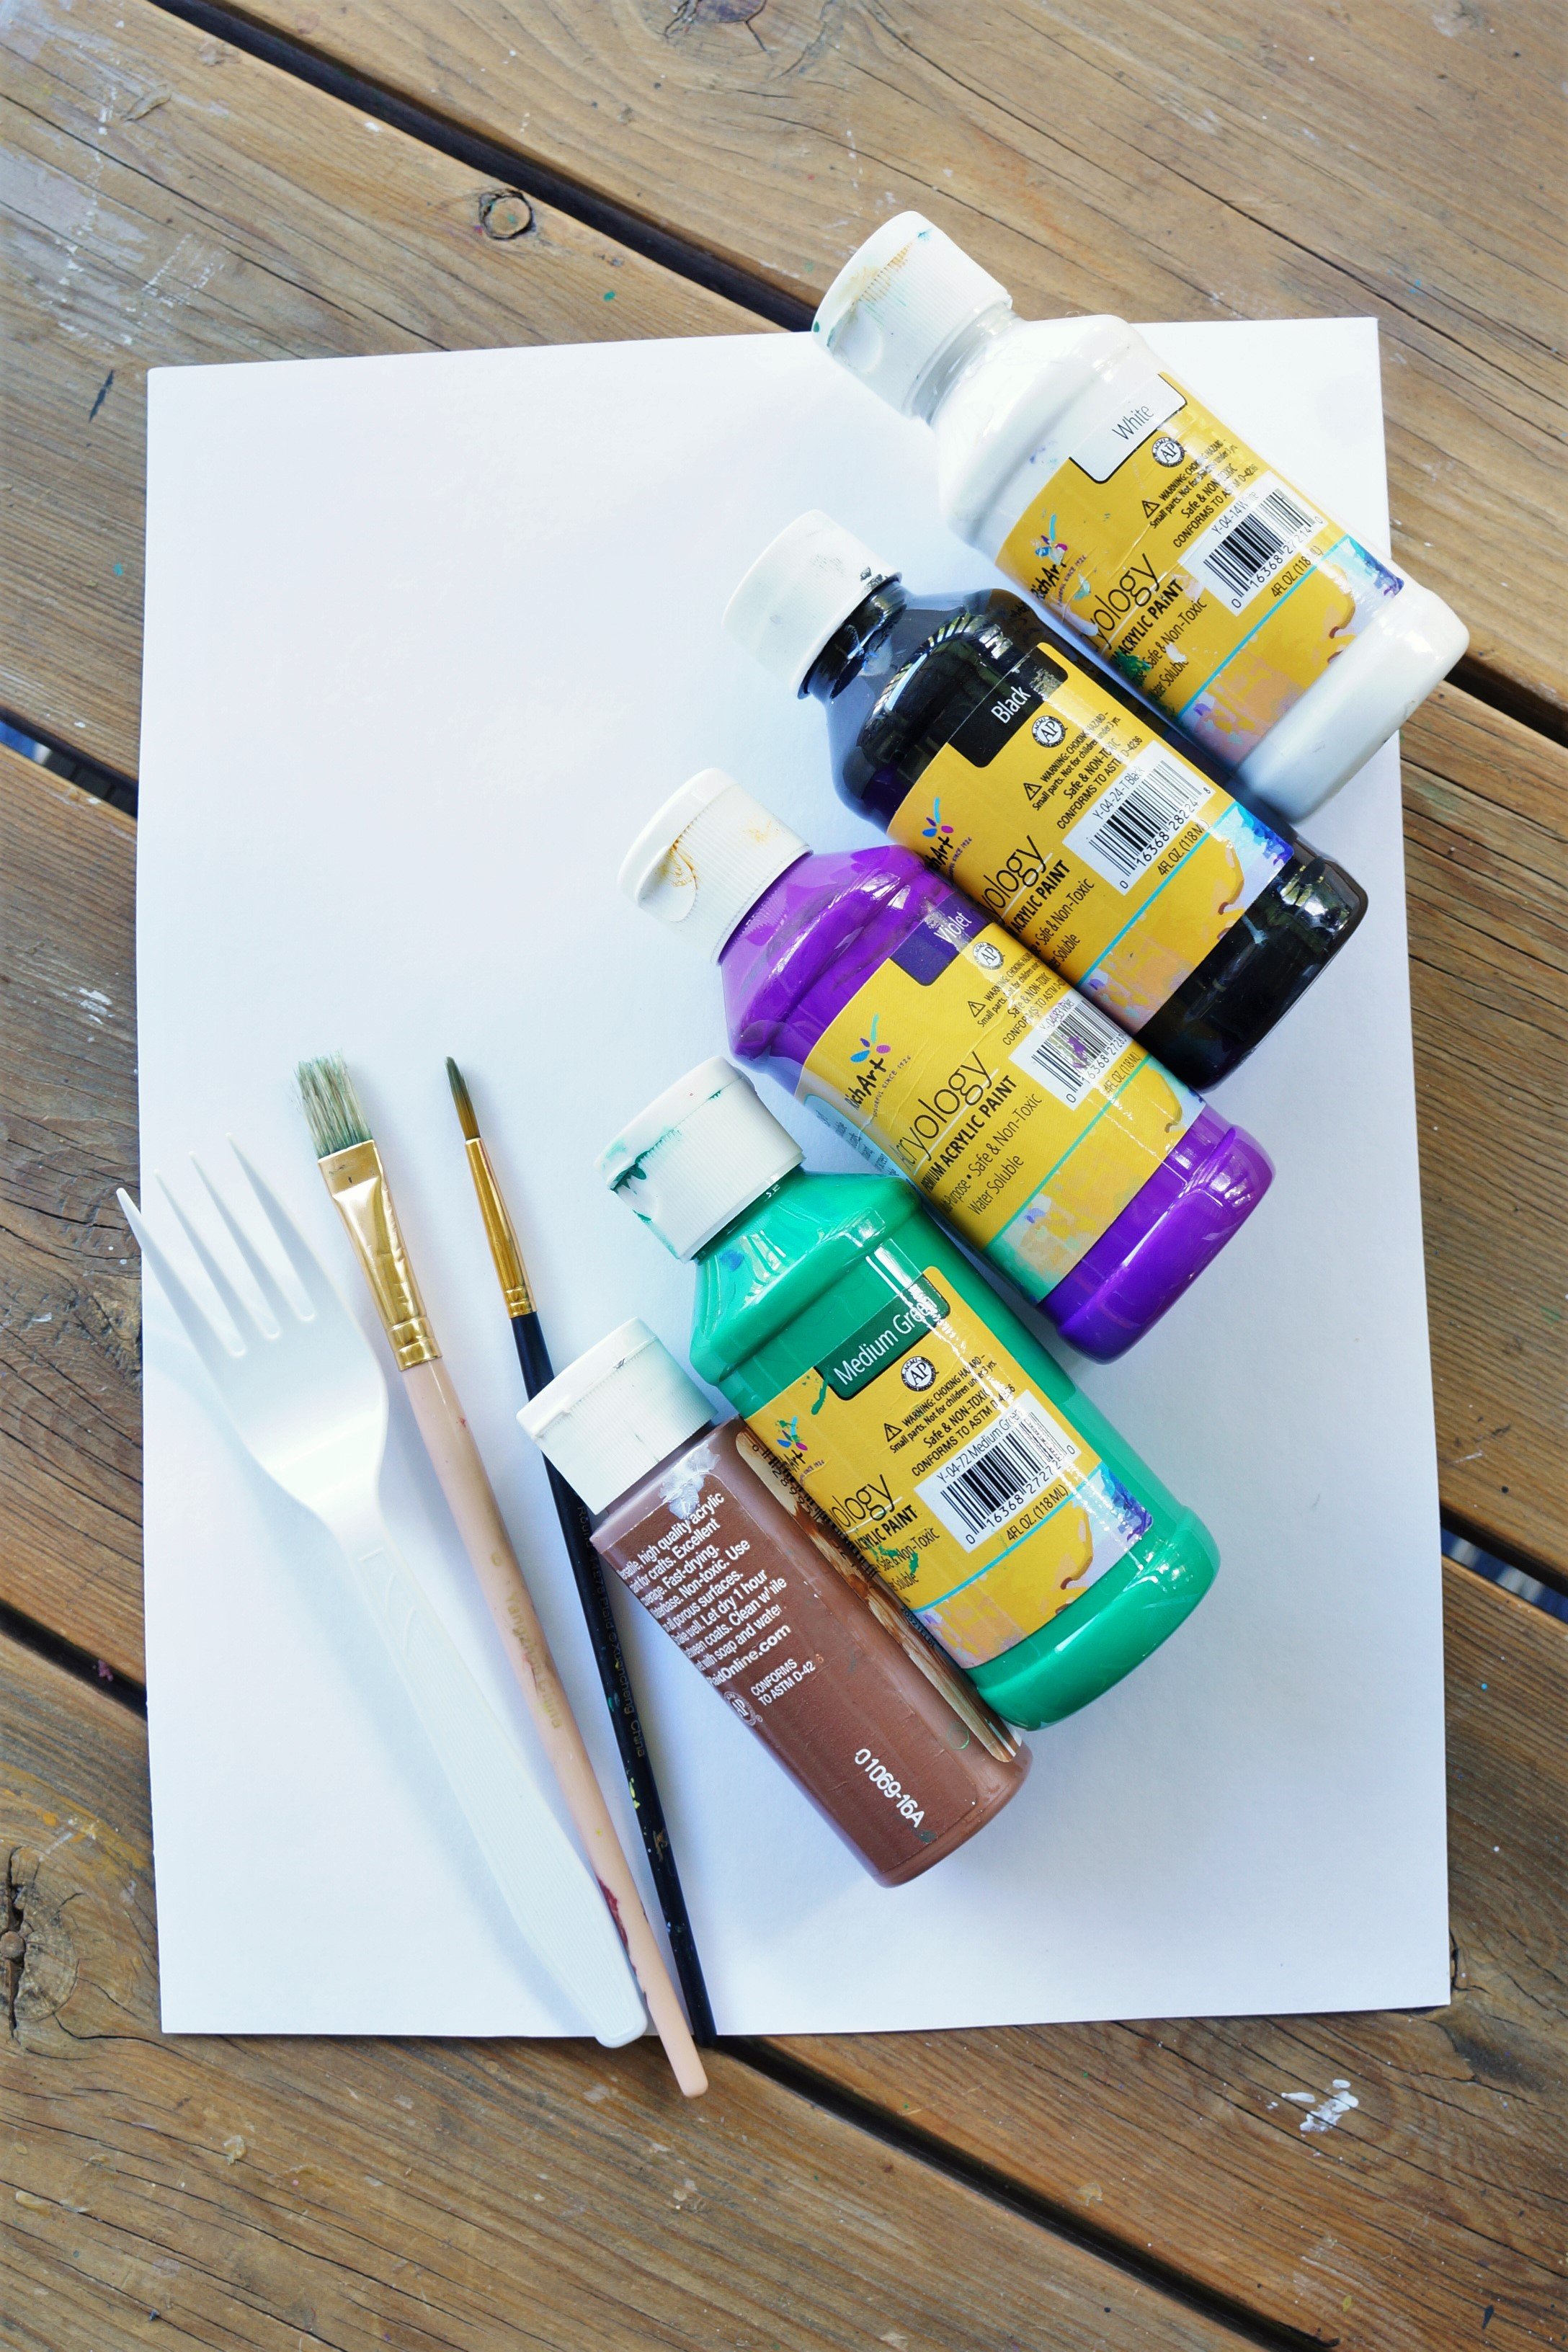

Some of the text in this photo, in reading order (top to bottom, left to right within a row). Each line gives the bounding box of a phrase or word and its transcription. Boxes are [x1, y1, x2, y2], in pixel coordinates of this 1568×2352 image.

[1110, 402, 1155, 442] White
[1159, 441, 1177, 463] AP
[1149, 484, 1193, 530] Small parts. Not
[1157, 473, 1187, 502] WARNING:
[1180, 500, 1200, 519] Safe
[1195, 493, 1207, 503] &
[1172, 504, 1214, 548] CONFORMS
[1210, 494, 1224, 507] TO
[1210, 504, 1243, 535] Y-04-14
[1230, 597, 1242, 609] 0
[1249, 553, 1283, 588] 16368
[1270, 581, 1288, 597] 4FL
[1116, 614, 1154, 657] ACRYLIC
[1146, 578, 1183, 620] PAINT
[1159, 597, 1208, 646] Non-Toxic
[990, 685, 1031, 723] Black
[1040, 719, 1059, 742] AP
[1031, 790, 1051, 811] Small
[1046, 776, 1065, 796] parts.
[1059, 764, 1074, 778] Not
[1069, 756, 1082, 767] for
[1038, 752, 1070, 783] WARNING:
[1056, 734, 1144, 829] CONFORMS TO AST D-4236
[1062, 780, 1084, 800] Safe
[1077, 772, 1090, 783] &
[1091, 779, 1130, 820] Y-04-24-T
[1118, 879, 1129, 889] 0
[1133, 830, 1170, 867] 16368
[1167, 798, 1200, 832] 28224
[1156, 829, 1198, 876] 4FL OZ. (118
[1006, 858, 1070, 934] ACRYLIC PAINT
[1049, 877, 1095, 926] Non-Toxic
[932, 909, 973, 946] Violet
[1033, 926, 1054, 946] Safe
[1044, 919, 1059, 932] &
[1051, 933, 1081, 963] Soluble
[980, 944, 997, 966] AP
[1004, 958, 1025, 979] CHOKING
[976, 1008, 995, 1028] Small
[991, 997, 1008, 1015] parts.
[1034, 997, 1048, 1010] TO
[843, 1056, 894, 1109] RichArt
[880, 1069, 899, 1090] SINCE
[896, 1054, 912, 1070] 1926
[1064, 1092, 1077, 1103] 0
[1078, 1053, 1111, 1085] 16368
[883, 1047, 1006, 1173] Acryology
[938, 1113, 985, 1168] ACRYLIC
[977, 1074, 1017, 1118] PAINT
[967, 1092, 1043, 1177] Safe & Non-Toxic
[966, 1154, 1024, 1216] Water Soluble
[832, 1329, 899, 1385] Medium
[909, 1360, 929, 1386] AP
[888, 1434, 909, 1453] Small
[906, 1422, 927, 1442] parts.
[922, 1411, 938, 1425] Not
[934, 1404, 947, 1415] for
[945, 1384, 970, 1407] children
[901, 1398, 936, 1427] WARNING:
[932, 1373, 961, 1402] CHOKING
[910, 1404, 993, 1476] CONFORMS TO ASTM
[922, 1429, 945, 1449] Safe
[940, 1421, 953, 1433] &
[935, 1427, 1003, 1484] Y-04-72 Medium
[964, 1533, 976, 1545] 0
[985, 1493, 1024, 1528] 16368
[1064, 1443, 1077, 1456] 0
[1005, 1483, 1069, 1541] 4FL OZ. (118 ML)
[636, 1491, 725, 1565] high quality acrylic
[881, 1503, 918, 1537] PAINT
[647, 1556, 677, 1580] crafts.
[670, 1517, 721, 1560] Excellent
[661, 1544, 720, 1590] Fast-drying.
[891, 1524, 941, 1564] Non-Toxic
[677, 1539, 750, 1599] Non-toxic. Use
[890, 1568, 920, 1592] Soluble
[672, 1569, 744, 1629] porous surfaces.
[683, 1568, 767, 1639] well. Let dry 1 hour
[703, 1623, 734, 1646] coats.
[728, 1598, 762, 1626] Clean
[713, 1622, 757, 1660] soap and
[597, 1595, 616, 1631] Plaid
[627, 1717, 649, 1759] China
[749, 1657, 798, 1696] CONFORMS
[757, 1652, 826, 1706] TO ASTM D-426
